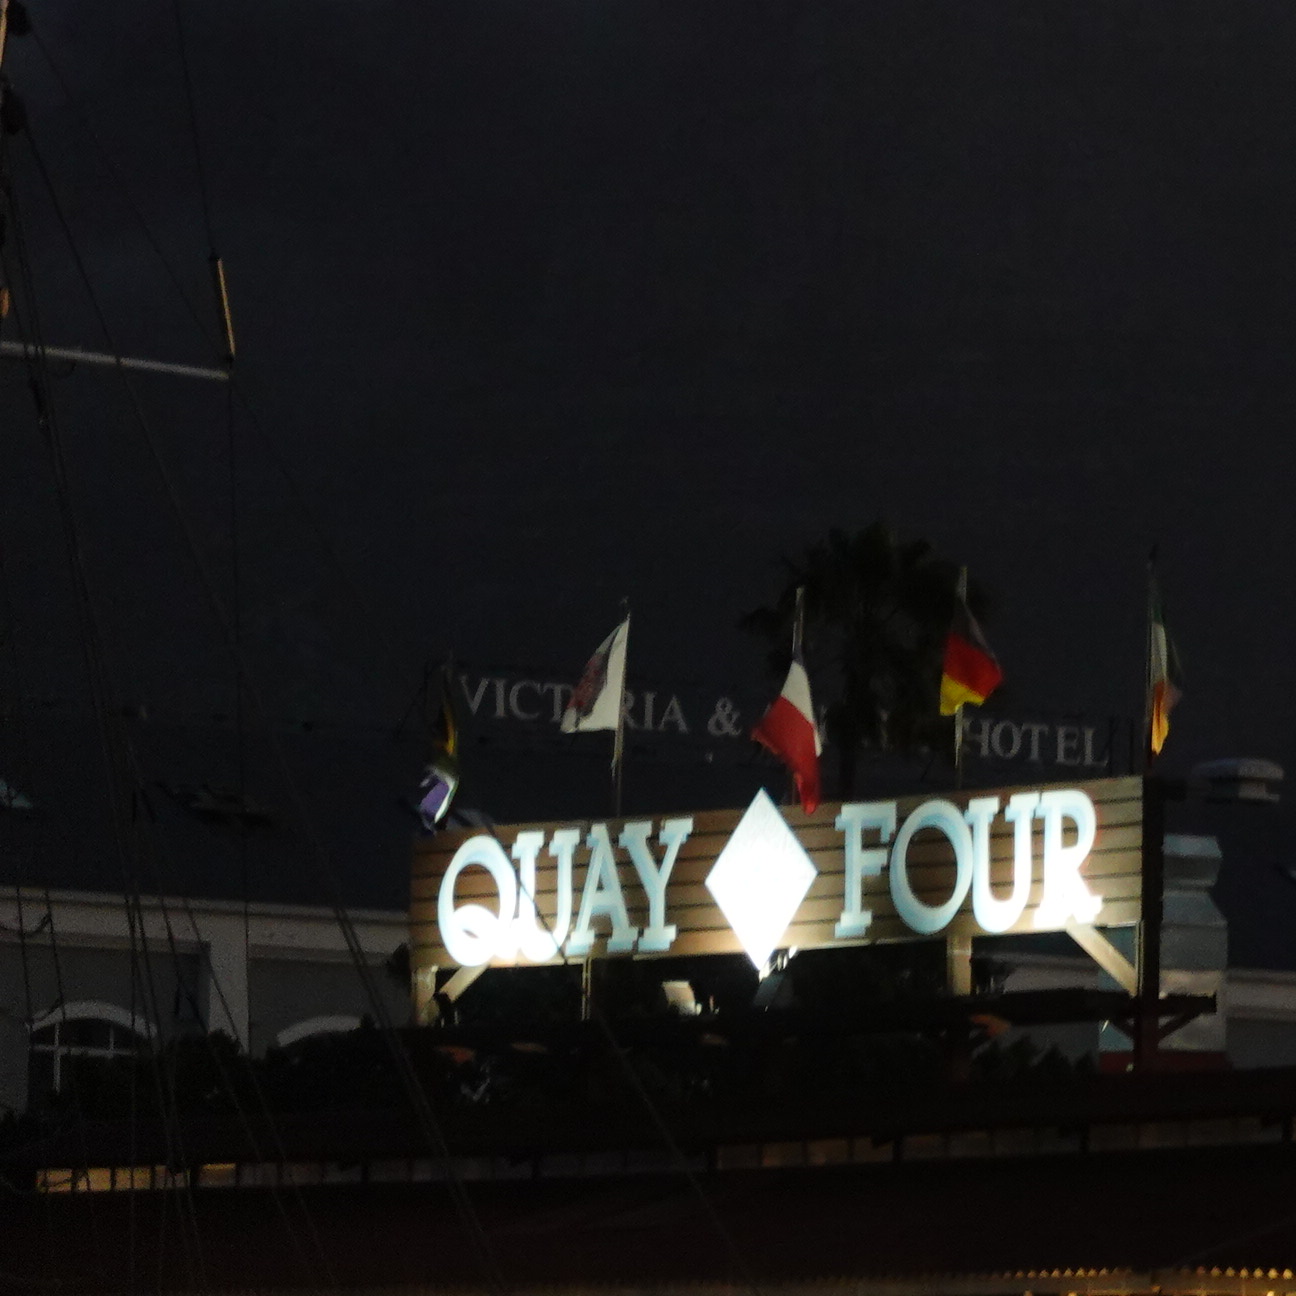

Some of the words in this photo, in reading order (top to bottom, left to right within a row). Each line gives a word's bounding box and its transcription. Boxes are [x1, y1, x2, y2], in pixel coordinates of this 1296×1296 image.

[461, 675, 689, 735] VICTRIA
[707, 697, 742, 736] &
[437, 818, 694, 968] QUAY
[834, 790, 1103, 938] FOUR
